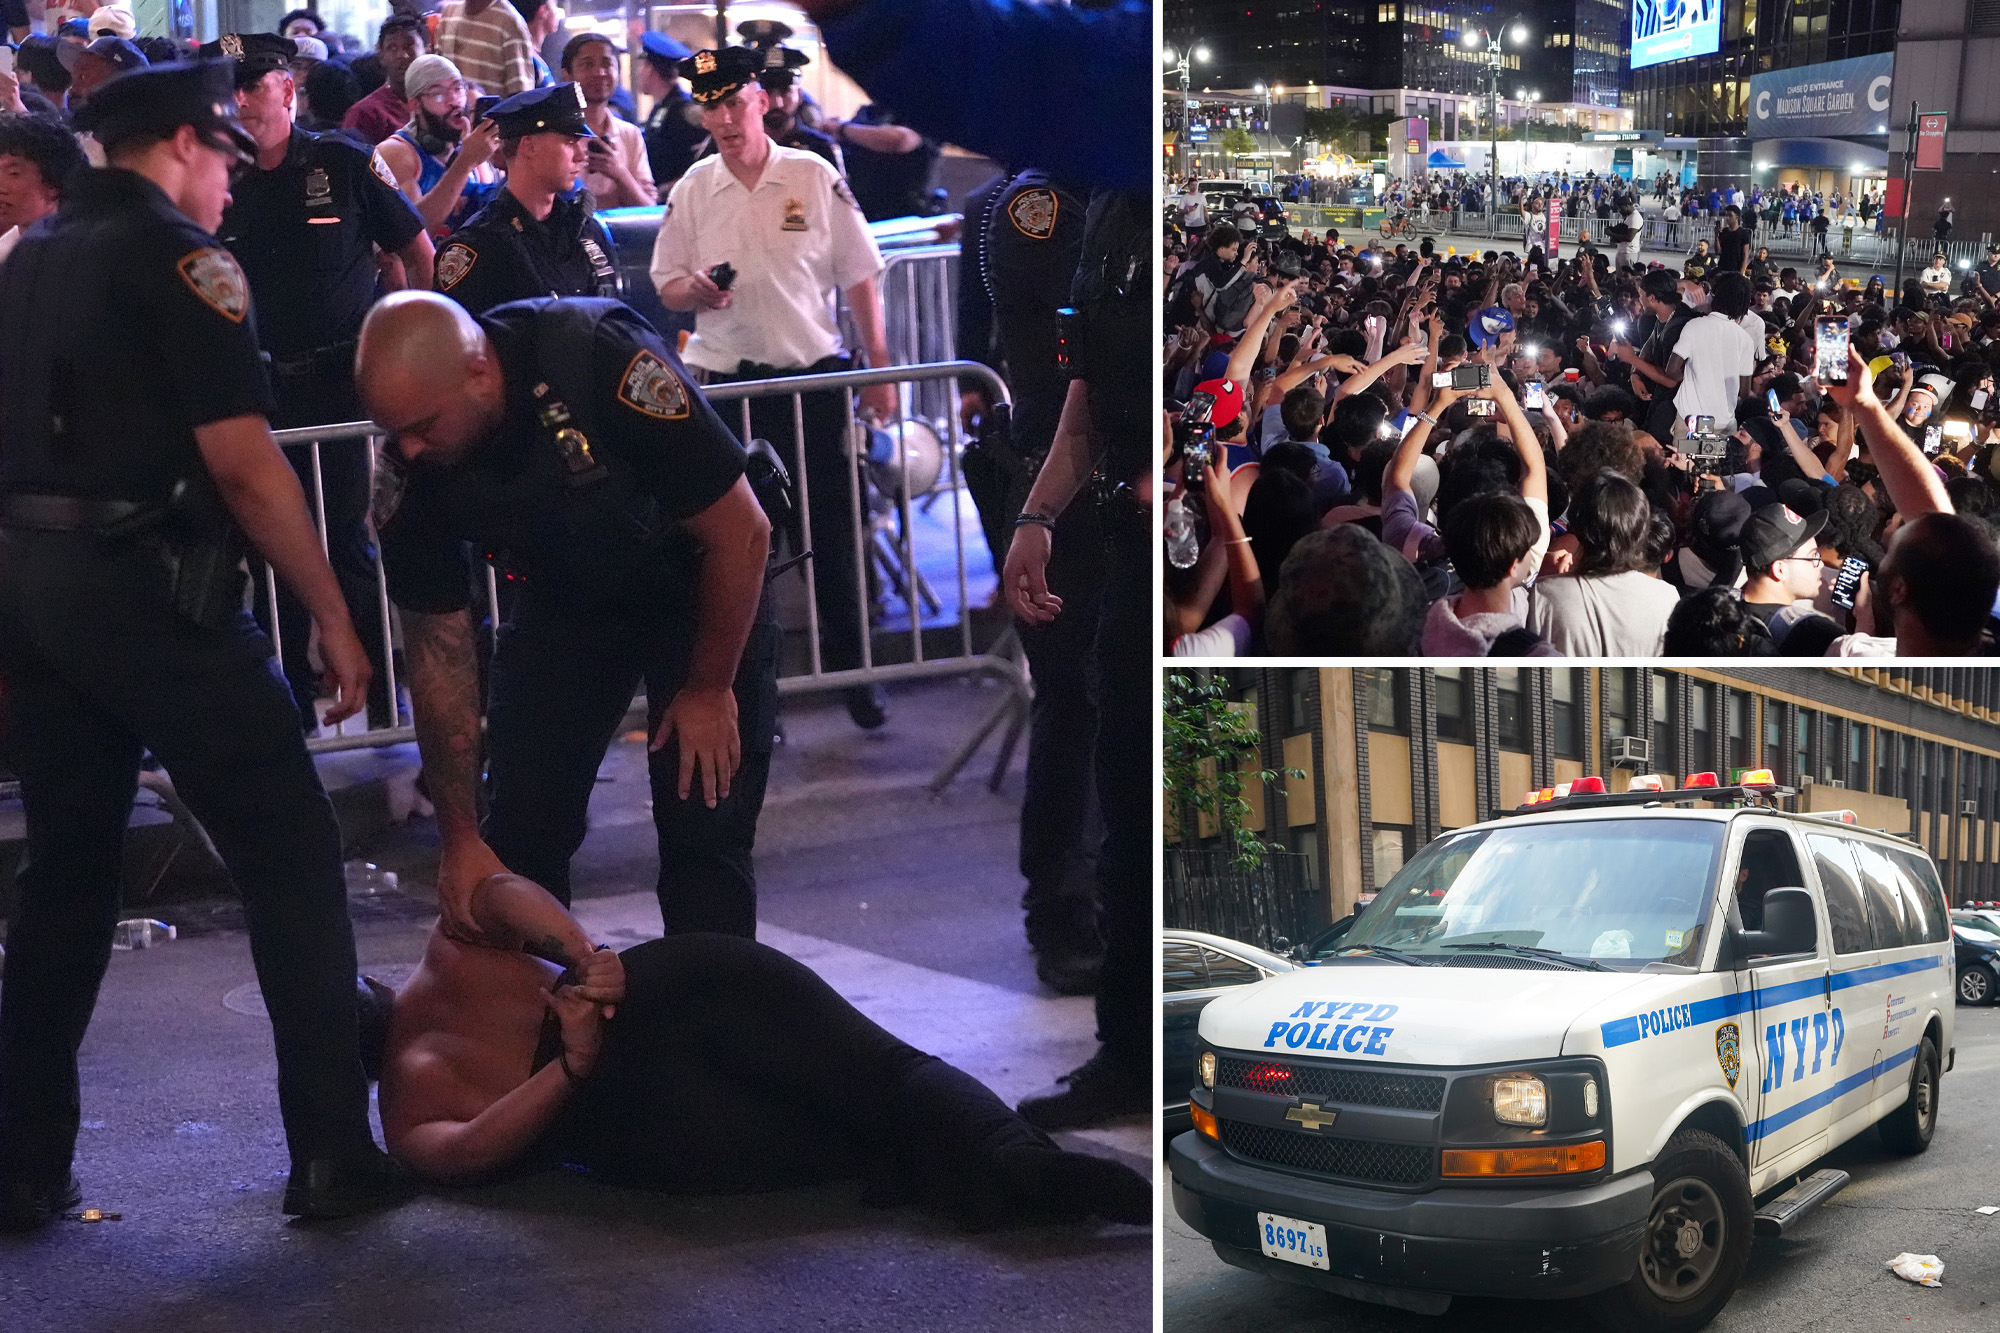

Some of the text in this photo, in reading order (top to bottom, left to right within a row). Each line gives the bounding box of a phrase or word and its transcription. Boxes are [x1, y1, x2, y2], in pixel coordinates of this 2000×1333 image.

[1787, 80, 1844, 94] CHASE ENTRANCE
[1776, 92, 1854, 115] MADISON SQUARE GARDEN
[645, 404, 663, 414] CITY
[1289, 1001, 1399, 1022] NYPD
[1639, 1004, 1691, 1039] POLICE
[1263, 1021, 1395, 1056] POLICE
[1721, 1025, 1734, 1034] POLICE
[1761, 1007, 1845, 1095] NYPD
[1265, 1223, 1323, 1257] 8697 15
